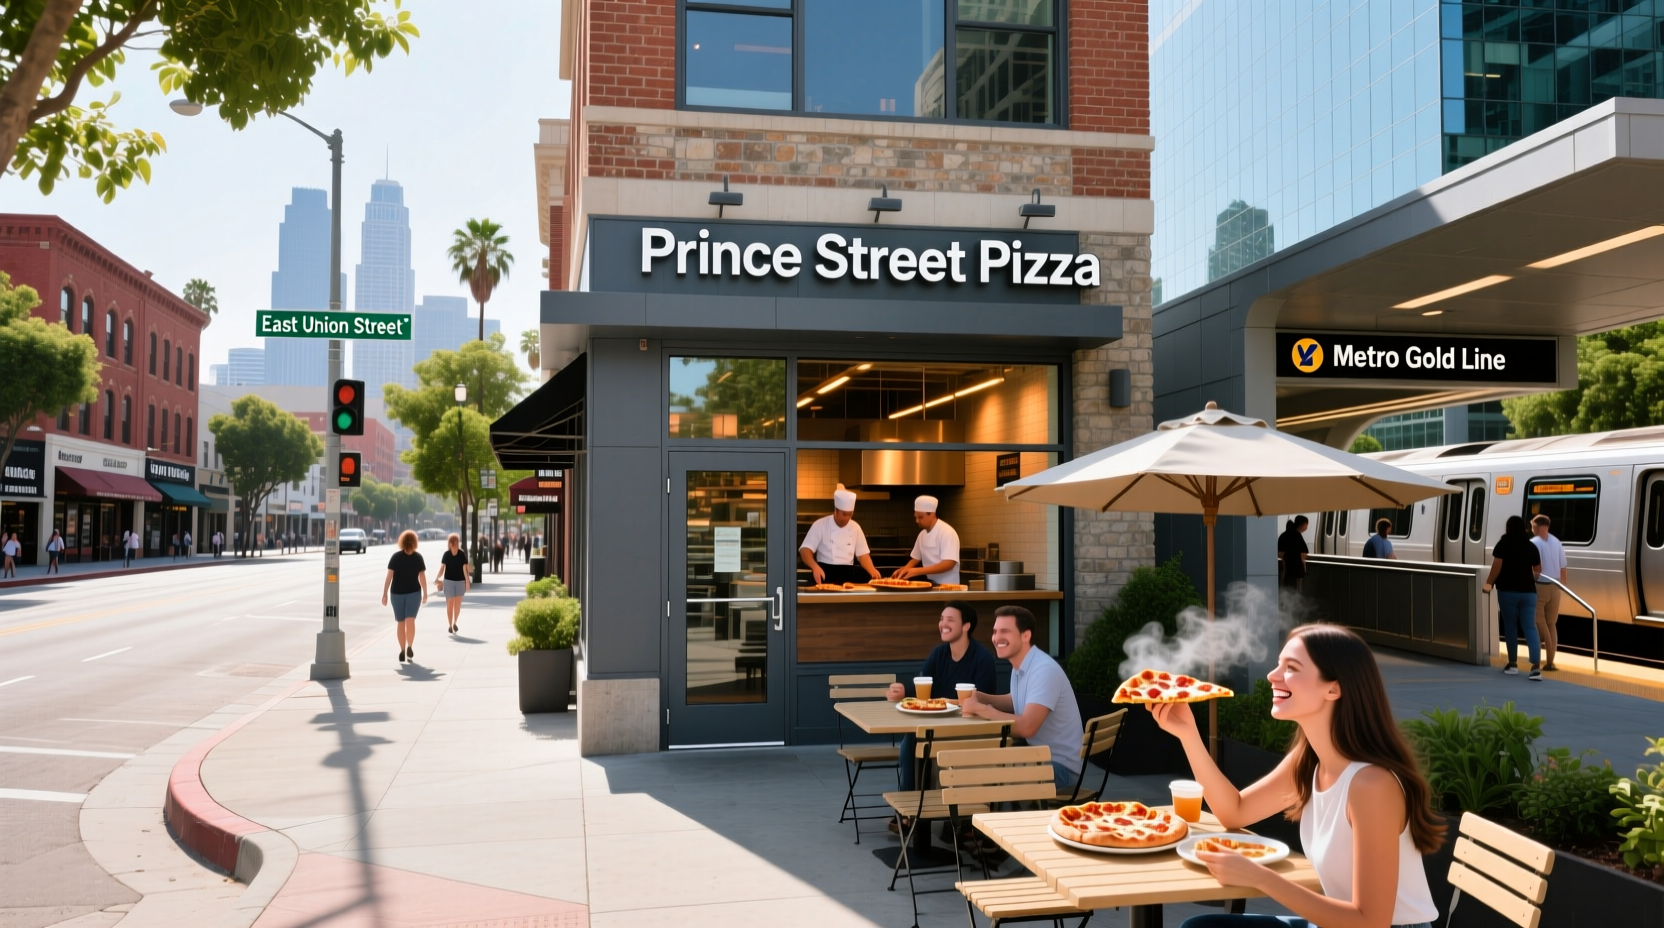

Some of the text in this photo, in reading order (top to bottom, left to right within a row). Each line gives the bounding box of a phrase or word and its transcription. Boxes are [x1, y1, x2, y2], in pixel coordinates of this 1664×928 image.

[641, 227, 1100, 286] Prince Street Pizza
[262, 315, 298, 332] East
[302, 315, 349, 333] Union
[1333, 344, 1506, 370] Metro Gold Line
